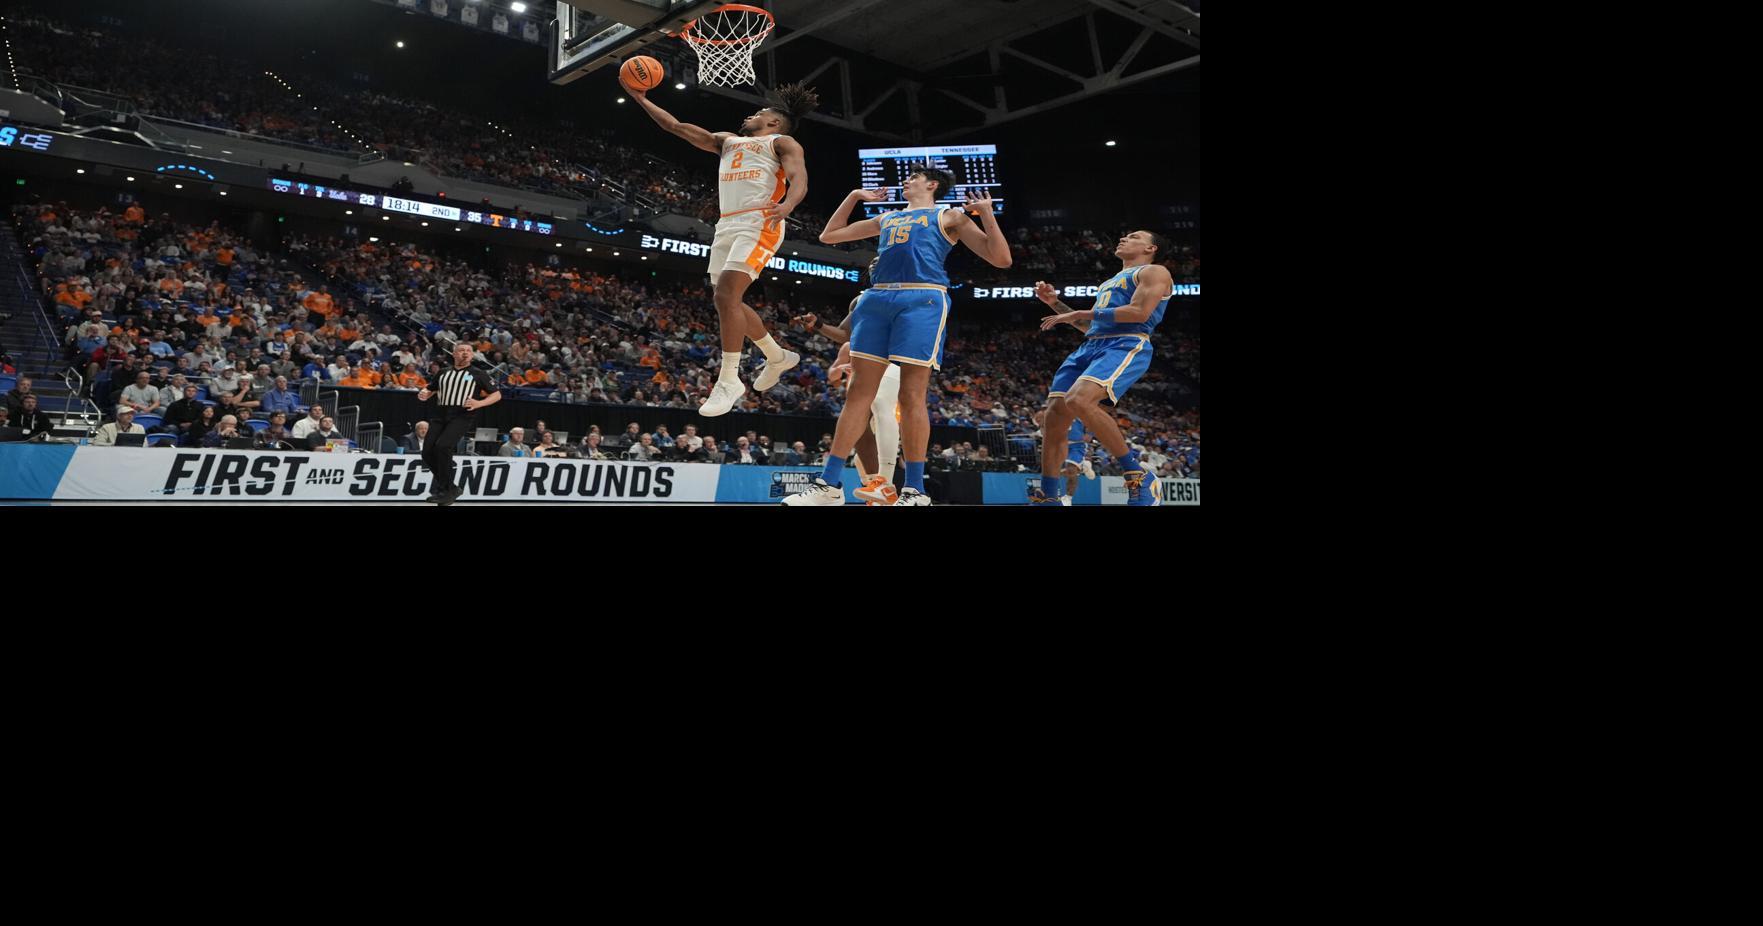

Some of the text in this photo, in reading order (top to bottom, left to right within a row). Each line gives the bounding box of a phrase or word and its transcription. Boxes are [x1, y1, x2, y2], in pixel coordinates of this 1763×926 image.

[731, 151, 744, 169] 2
[359, 193, 376, 207] 28
[388, 198, 420, 213] 18:14
[431, 206, 451, 218] 2ND
[345, 225, 358, 236] 14
[887, 225, 912, 246] 15
[661, 238, 711, 258] FIRST
[788, 259, 845, 280] ROUNDS
[163, 453, 310, 496] FIRST
[305, 468, 345, 486] AND
[520, 461, 675, 498] ROUNDS
[781, 473, 810, 483] MARCH
